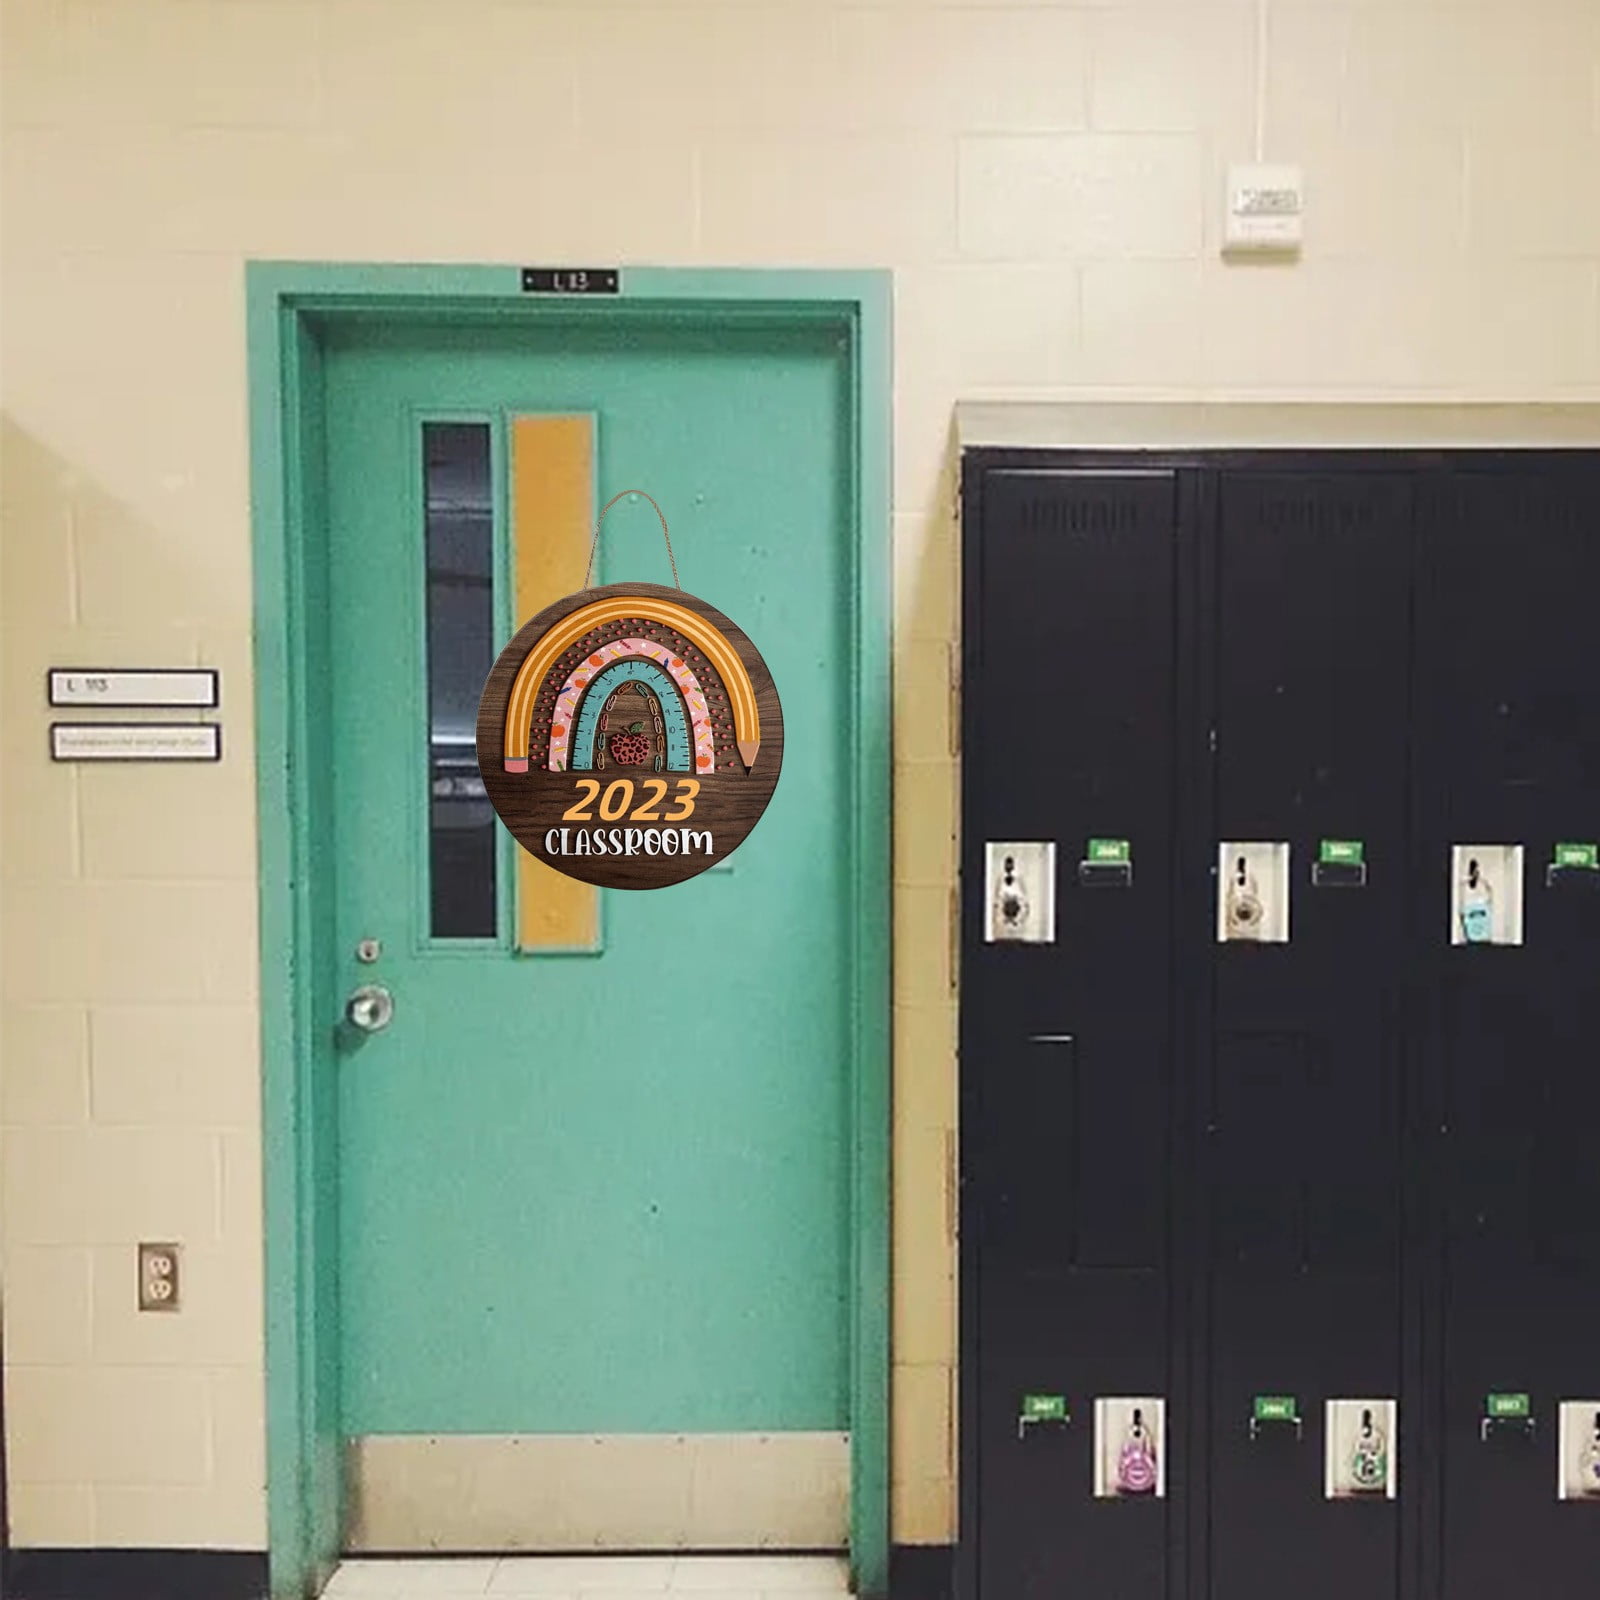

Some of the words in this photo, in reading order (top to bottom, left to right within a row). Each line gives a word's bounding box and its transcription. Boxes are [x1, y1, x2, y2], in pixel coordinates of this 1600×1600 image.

[67, 677, 75, 692] L
[85, 677, 108, 693] 113
[561, 778, 701, 822] 2023
[544, 827, 714, 856] CLASSROOM
